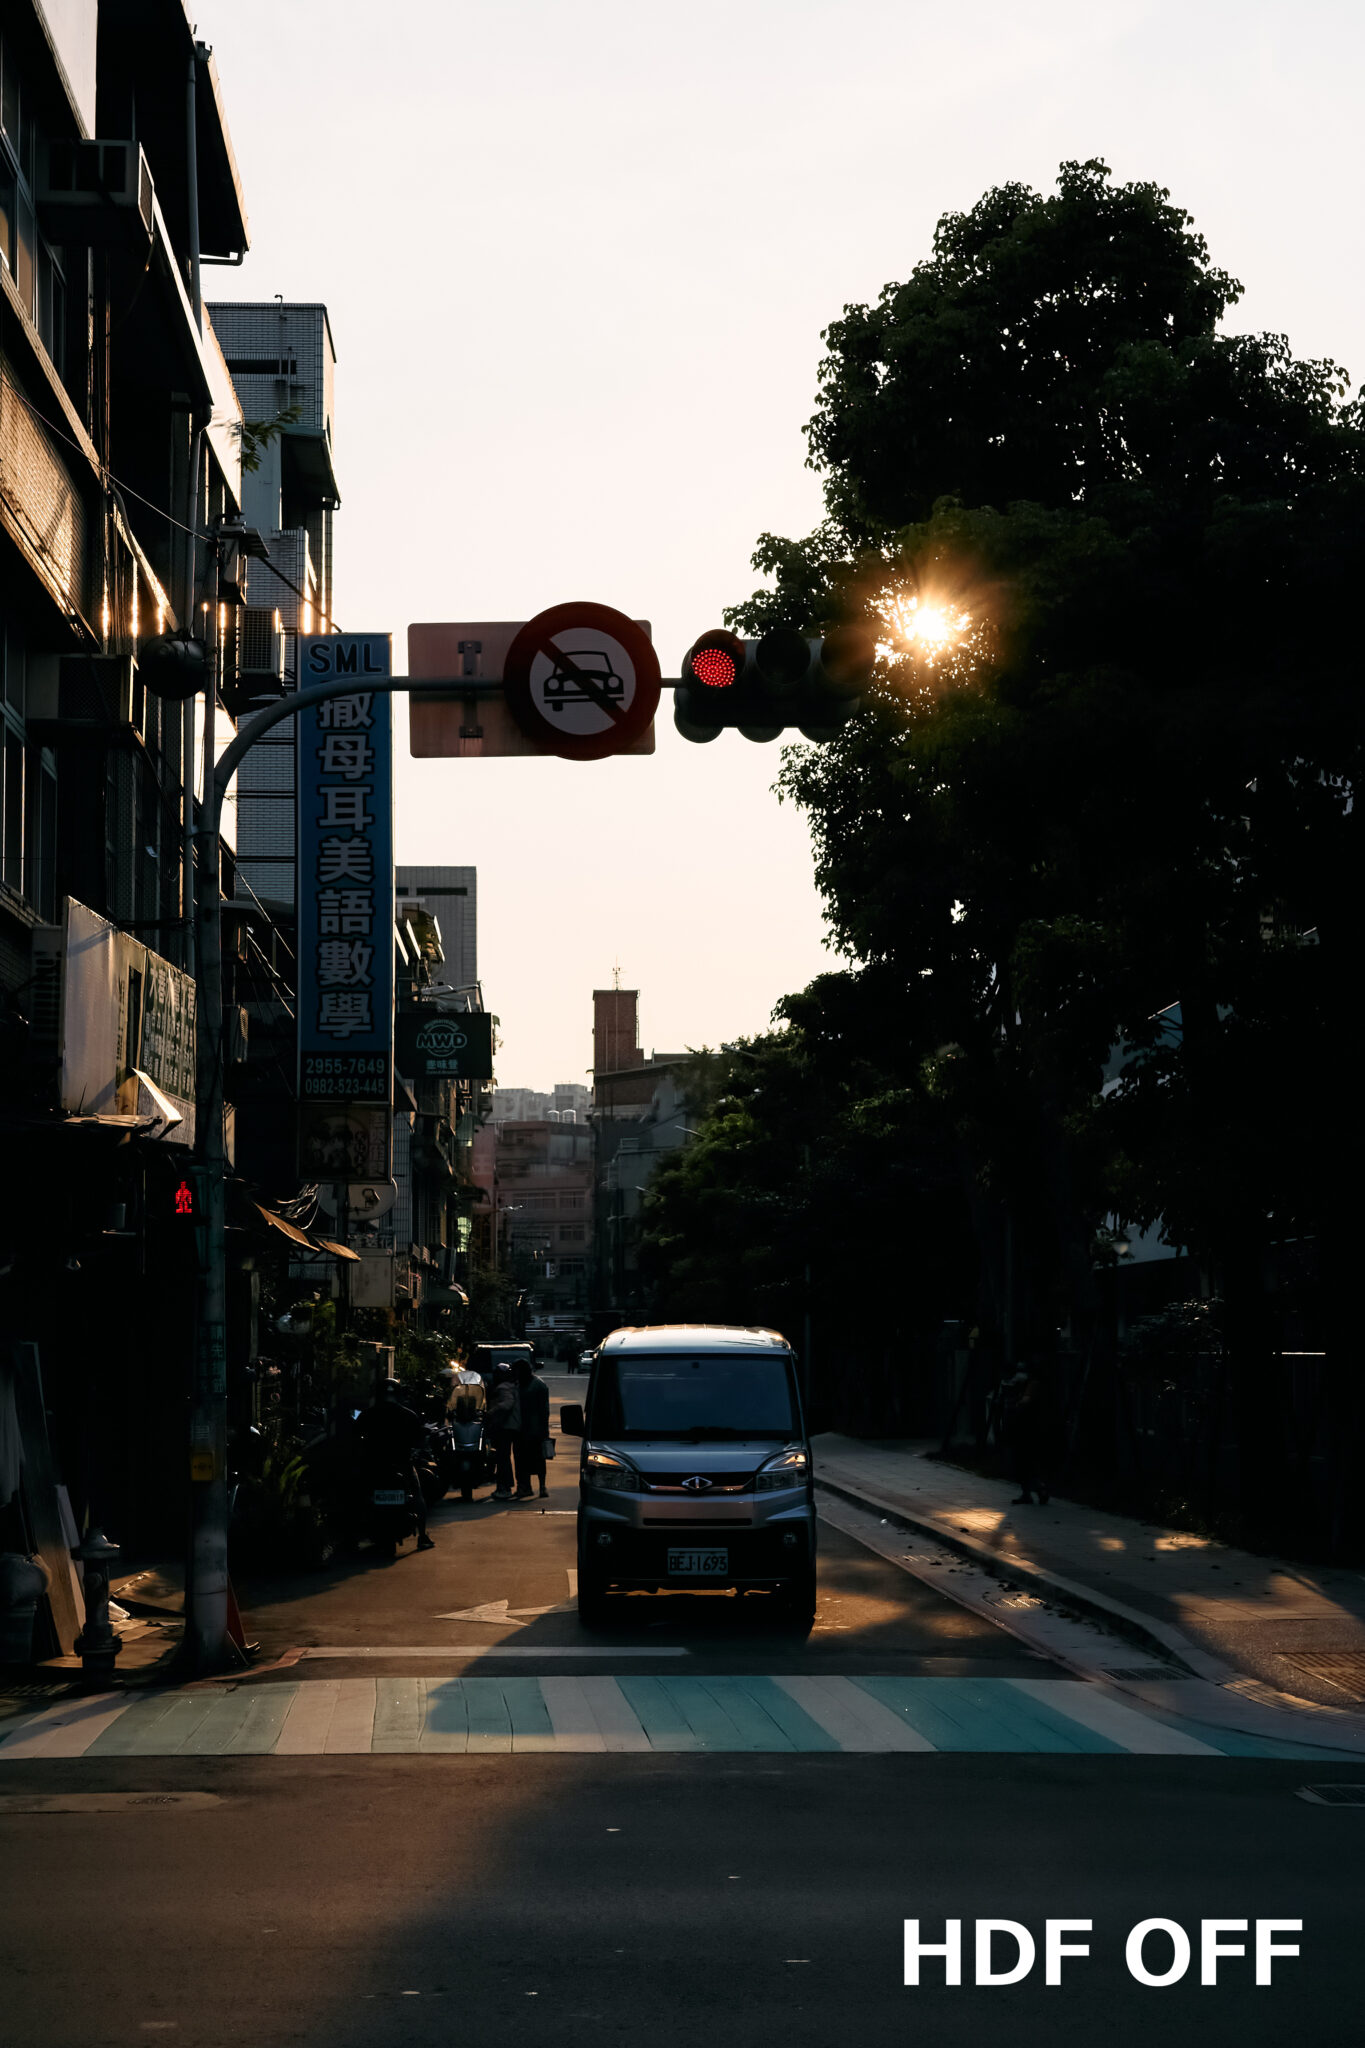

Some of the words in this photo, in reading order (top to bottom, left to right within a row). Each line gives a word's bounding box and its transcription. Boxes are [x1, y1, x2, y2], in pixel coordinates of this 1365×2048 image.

[309, 643, 383, 673] SML
[416, 1032, 468, 1049] MWD
[304, 1057, 385, 1075] 2955-7649
